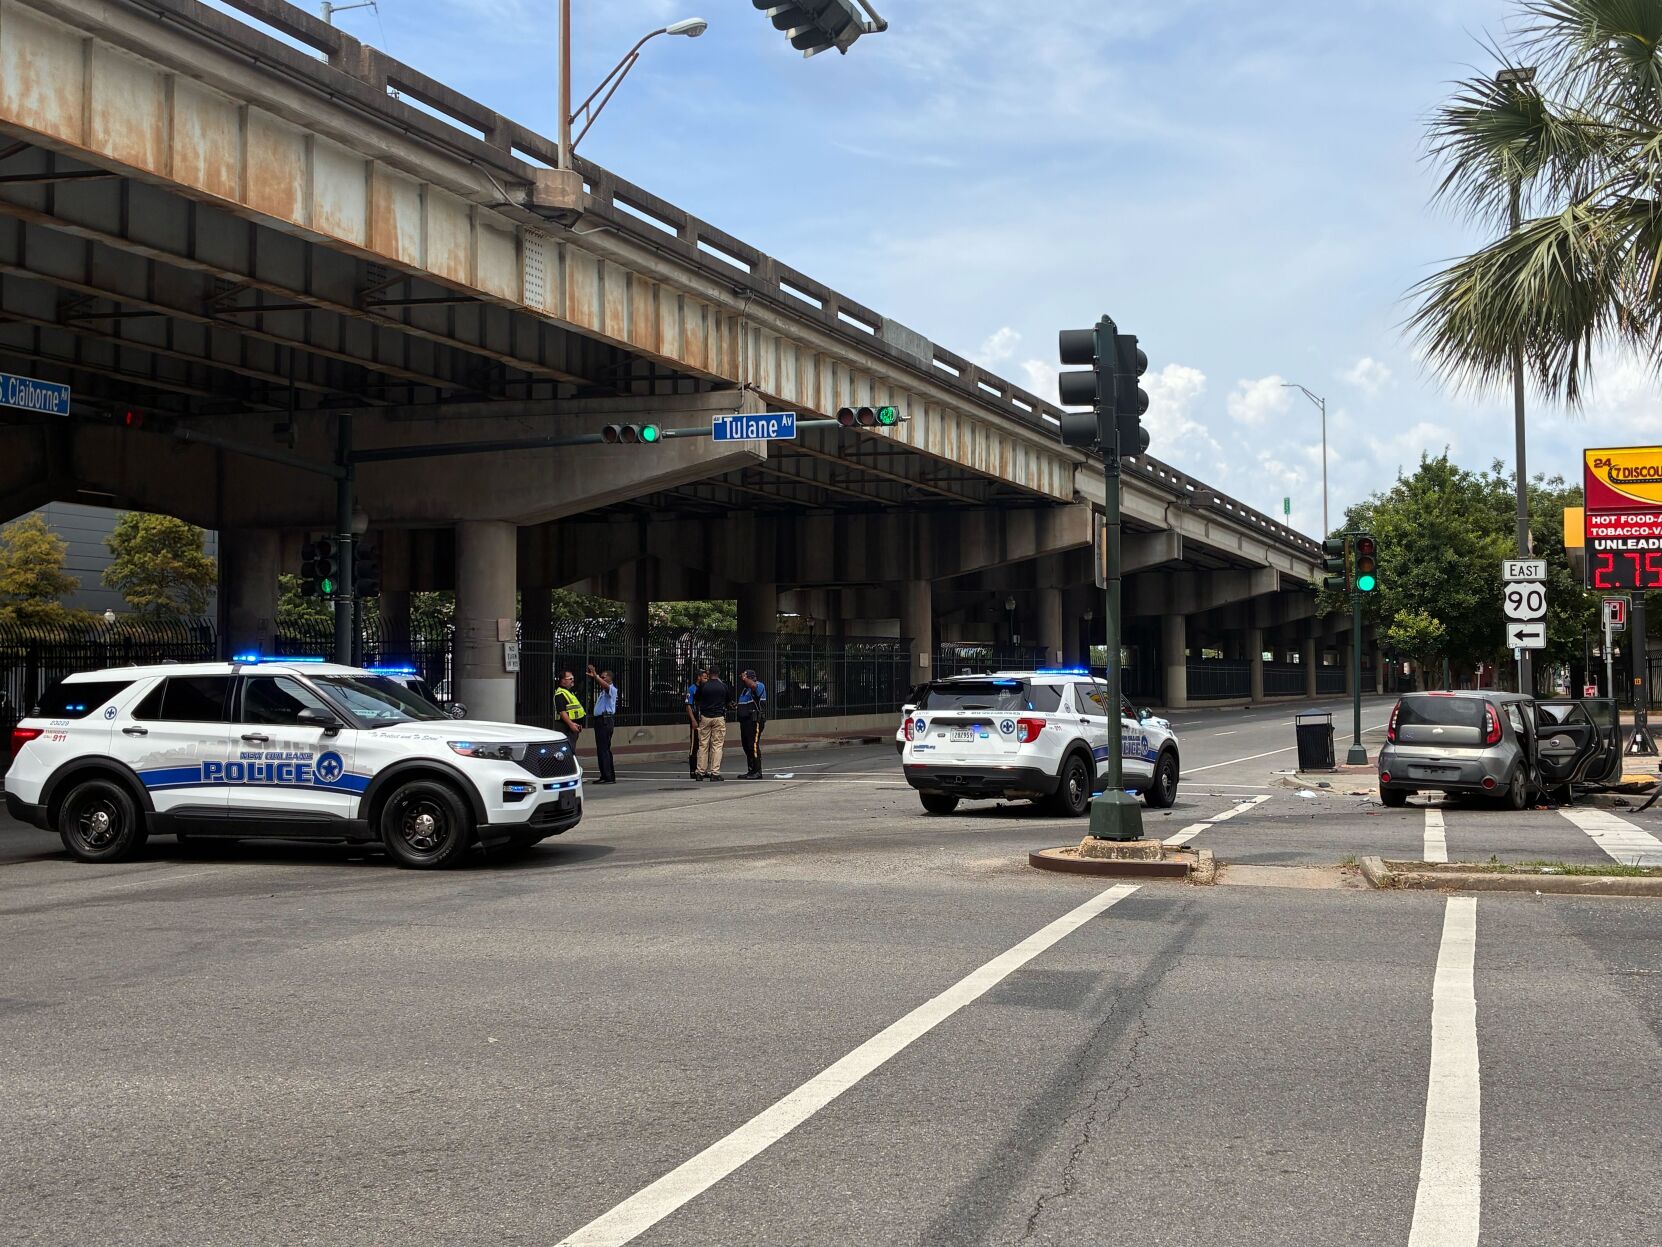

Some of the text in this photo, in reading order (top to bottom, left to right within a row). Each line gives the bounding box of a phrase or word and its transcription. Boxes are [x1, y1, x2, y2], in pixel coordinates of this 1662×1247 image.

[9, 377, 59, 411] Claiborne
[723, 414, 792, 439] Tulane Av
[1593, 458, 1612, 468] 24
[1591, 516, 1617, 524] HOT
[1509, 564, 1539, 577] EAST
[1595, 552, 1662, 588] 2.75
[1508, 590, 1543, 612] 90
[52, 734, 66, 742] 911
[240, 751, 314, 761] NEW ORLEANS
[1121, 741, 1141, 757] LICE
[201, 760, 314, 784] POLICE
